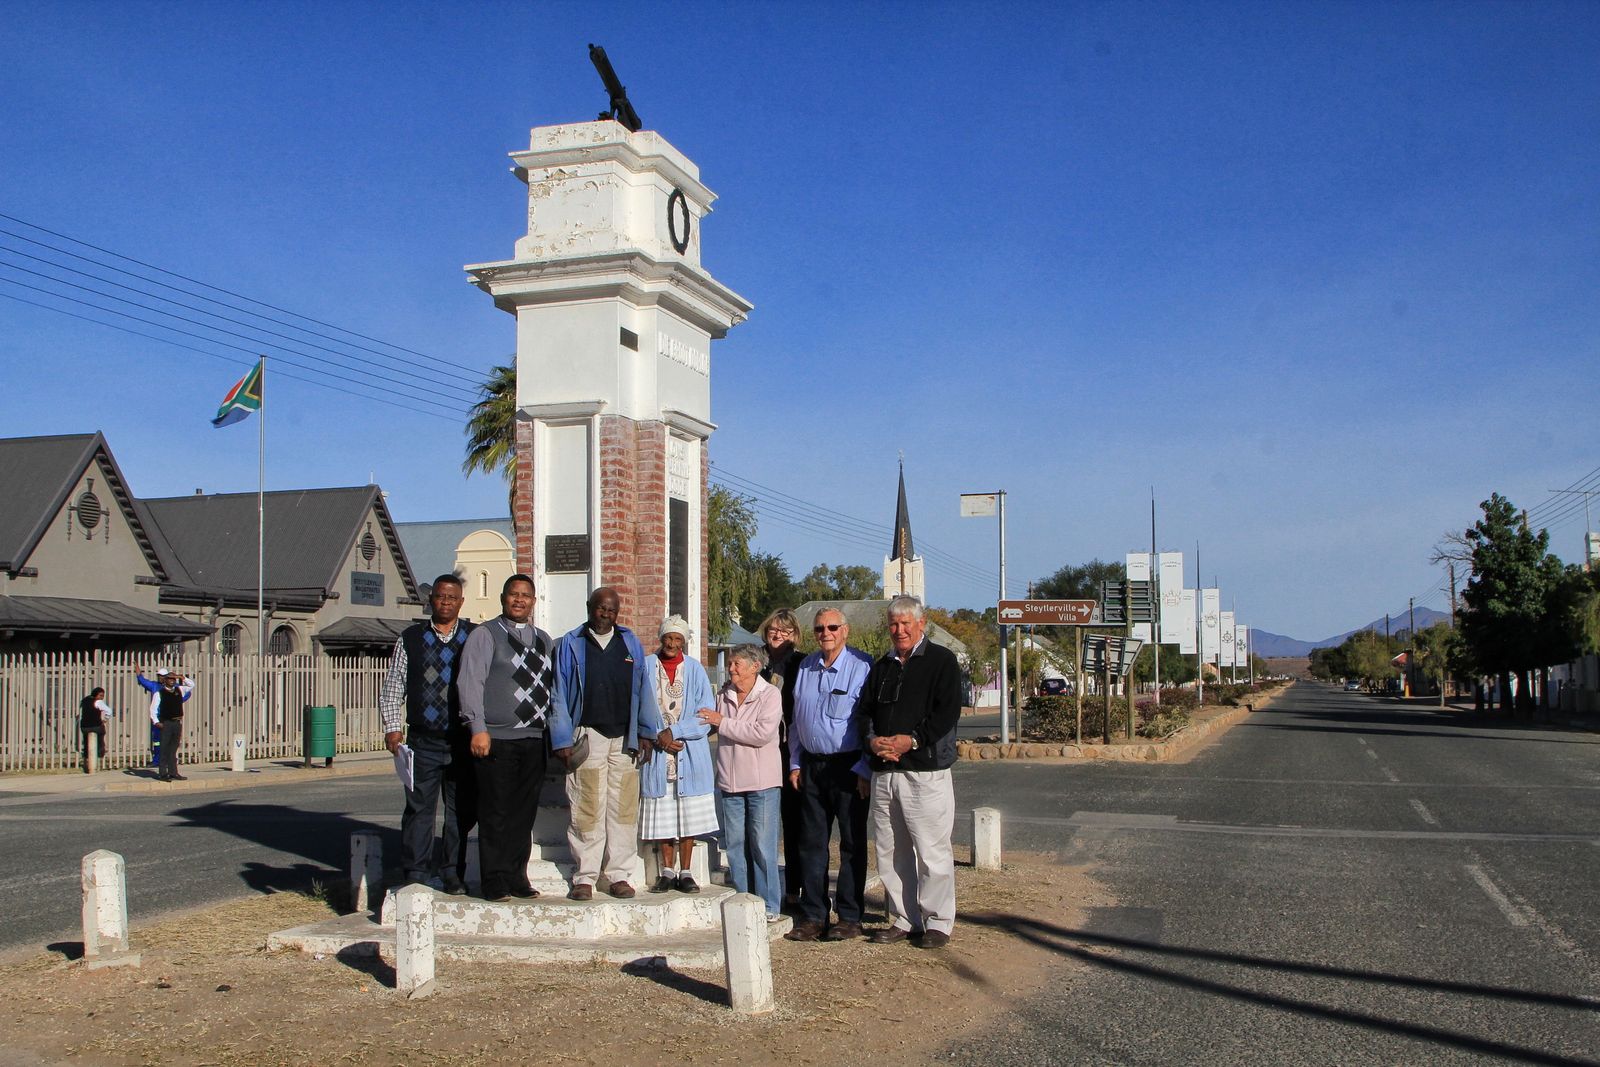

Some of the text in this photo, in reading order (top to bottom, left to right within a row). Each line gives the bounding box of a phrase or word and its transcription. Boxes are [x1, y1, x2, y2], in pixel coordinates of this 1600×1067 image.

[1024, 604, 1077, 613] Steytlerville
[1058, 613, 1077, 621] Villa
[236, 740, 243, 748] V
